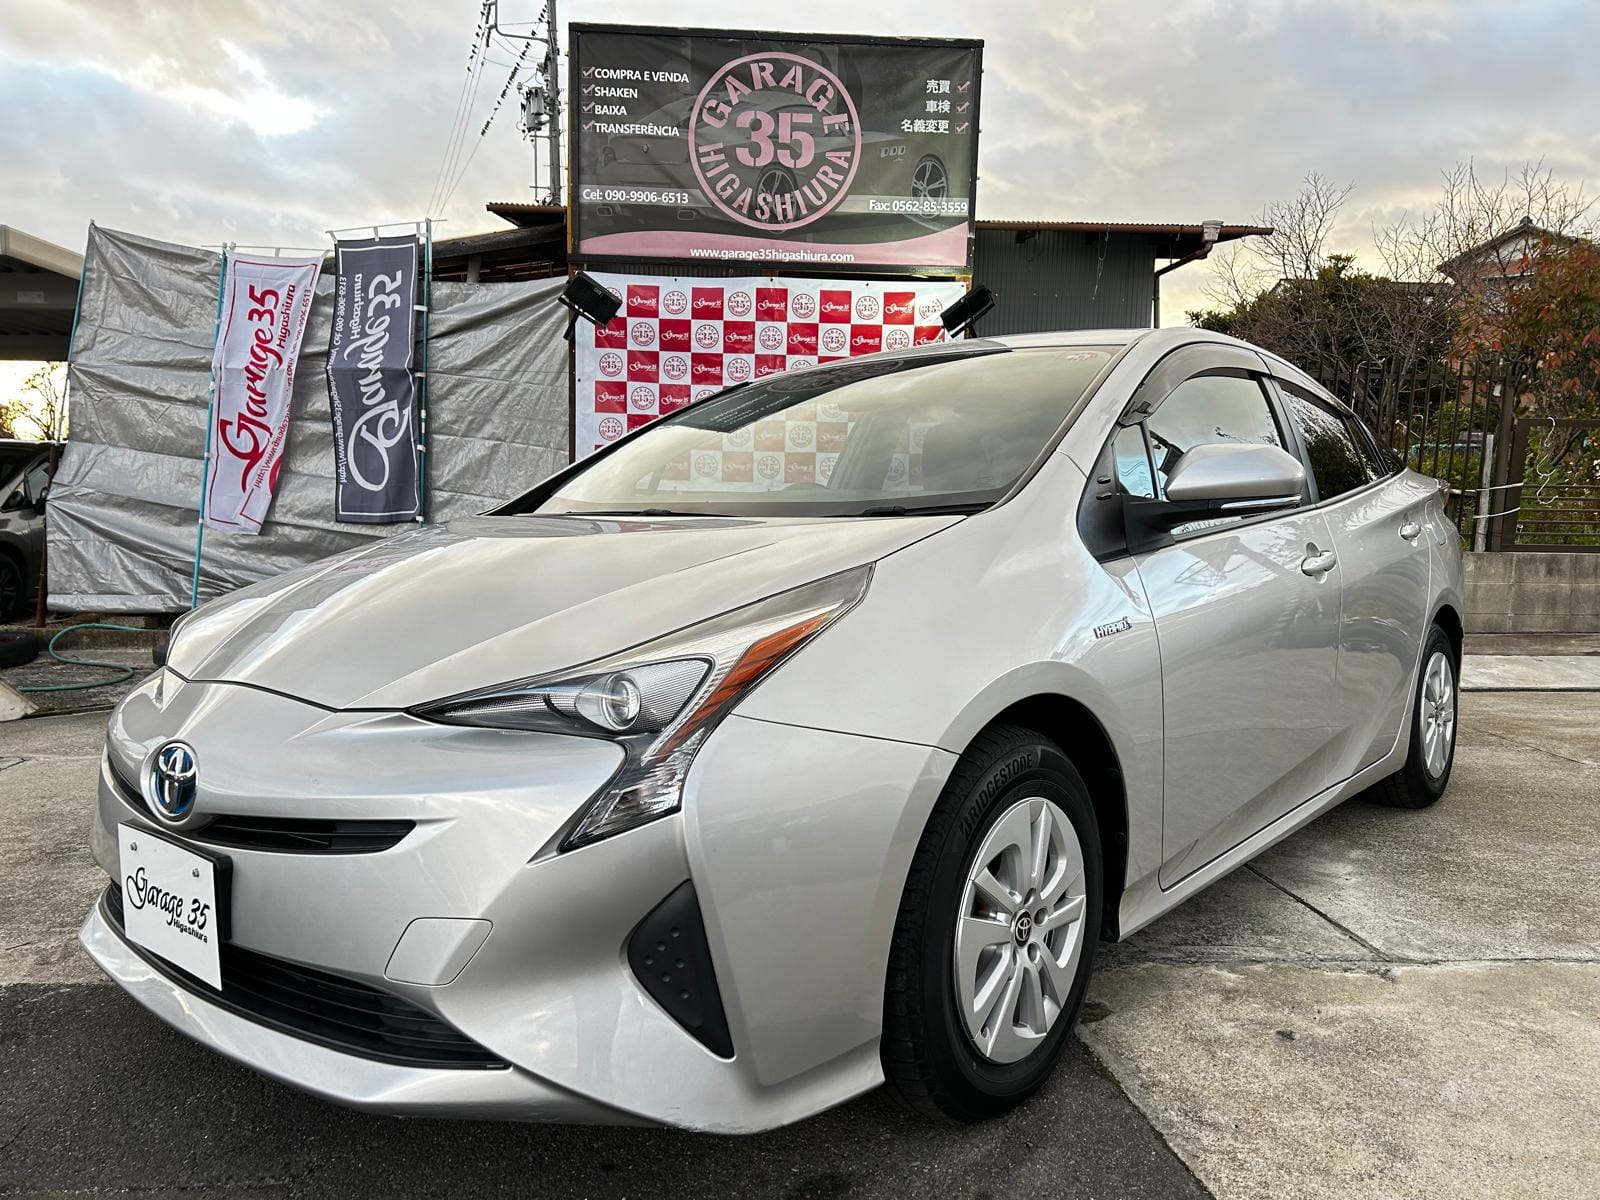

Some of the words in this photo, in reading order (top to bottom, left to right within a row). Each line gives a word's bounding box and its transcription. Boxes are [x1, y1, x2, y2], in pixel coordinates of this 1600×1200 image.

[594, 68, 641, 80] COMPRA
[644, 71, 650, 81] E
[652, 71, 689, 83] VENDA
[594, 87, 638, 98] SHAKEN
[926, 79, 950, 94] 売買
[702, 62, 850, 134] GARAGE
[594, 105, 627, 116] BAIXA
[925, 100, 951, 114] 車検
[594, 122, 680, 137] TRANSFERÊNCIA
[901, 118, 949, 134] 名義変更
[735, 110, 815, 169] 35
[698, 142, 851, 221] HIGASHIURA
[582, 188, 603, 200] Cel:
[605, 189, 689, 204] 090-9906-6513
[869, 199, 890, 211] Fax:
[892, 200, 968, 213] 0562-85-3559
[690, 248, 855, 263] www.garage35higashiura.com
[248, 284, 280, 326] 35
[276, 284, 296, 350] Higashiura
[219, 328, 284, 494] Garage
[1095, 619, 1127, 639] HYBRID
[126, 867, 183, 926] Garage
[187, 898, 210, 930] 35
[173, 918, 208, 943] Higashiura
